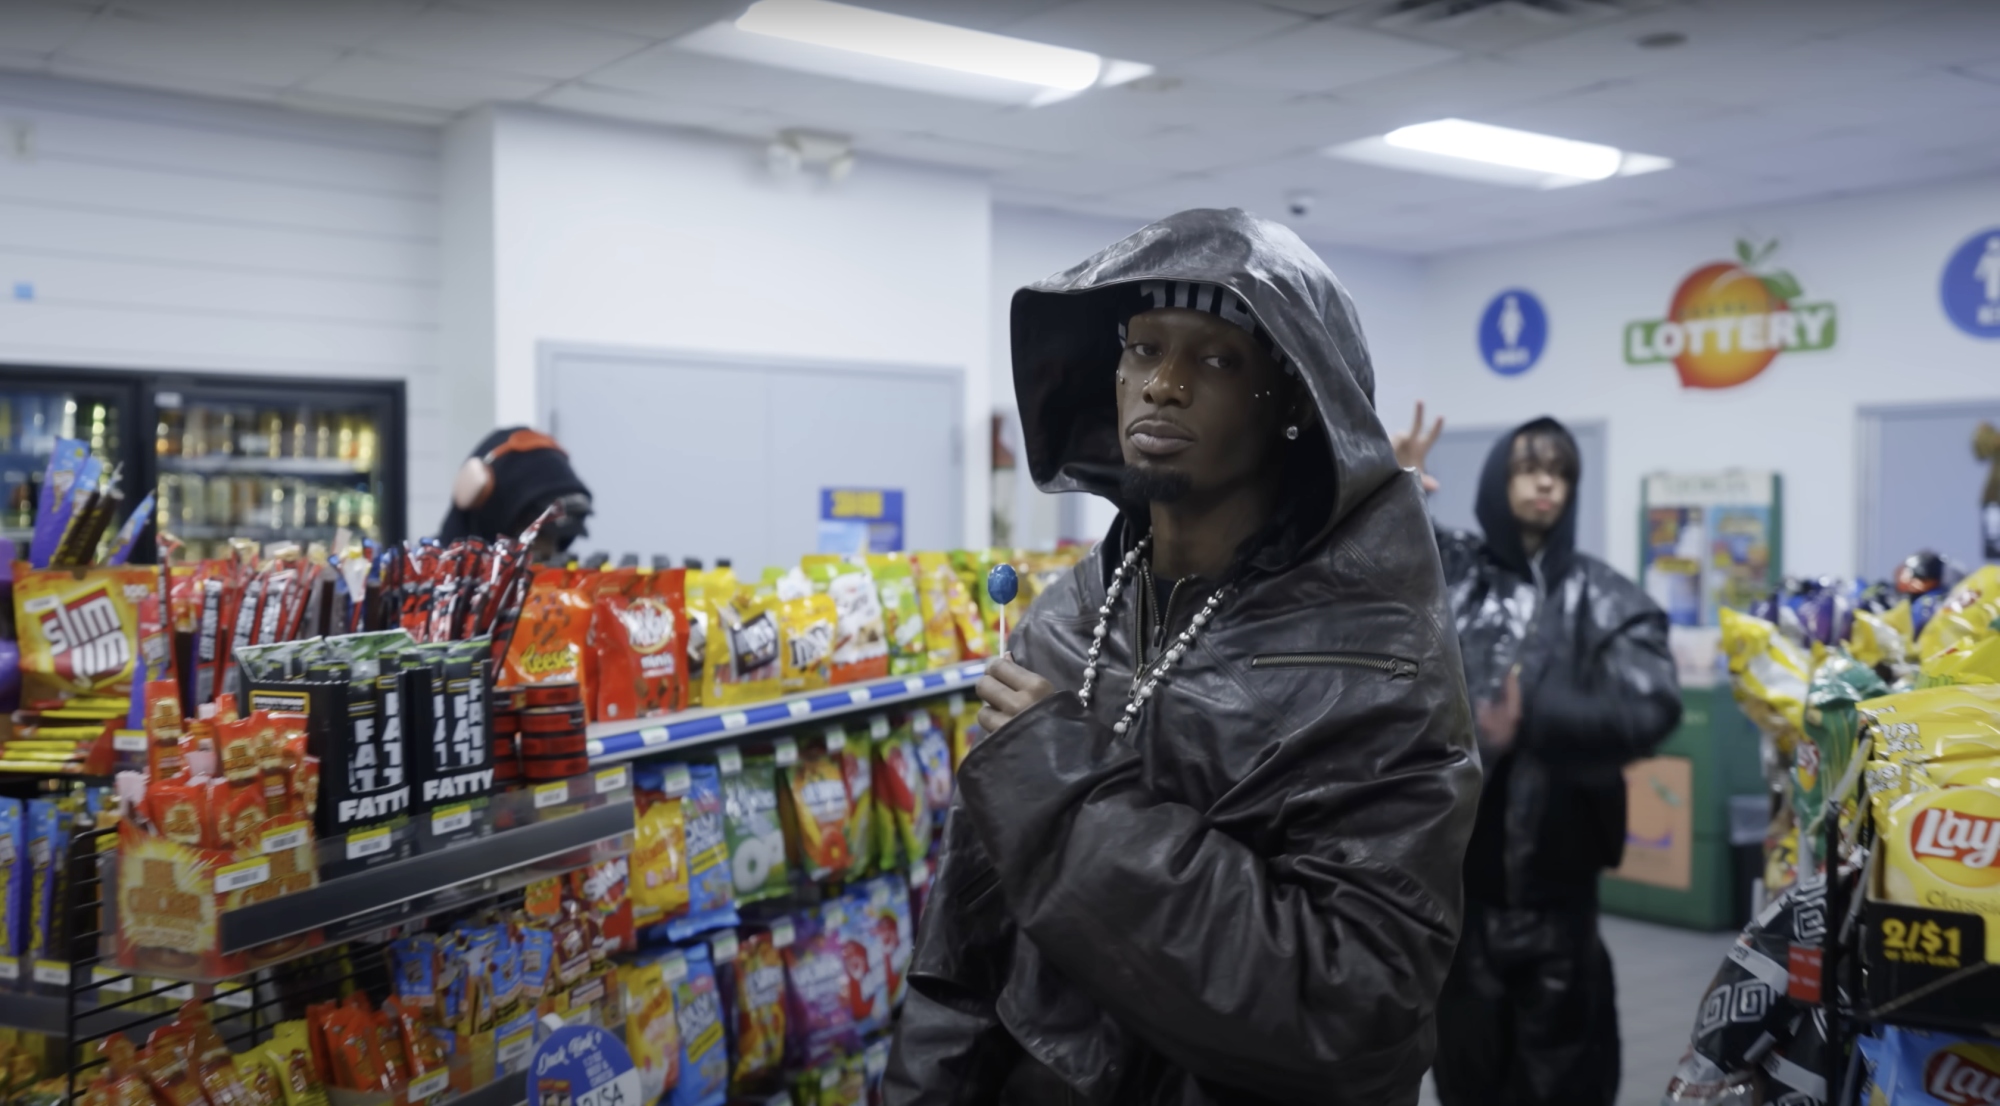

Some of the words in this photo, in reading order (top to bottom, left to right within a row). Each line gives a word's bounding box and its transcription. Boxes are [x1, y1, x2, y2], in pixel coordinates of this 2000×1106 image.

[1631, 308, 1833, 360] LOTTERY
[422, 768, 495, 803] FATTY
[1881, 918, 1961, 957] 2/$1
